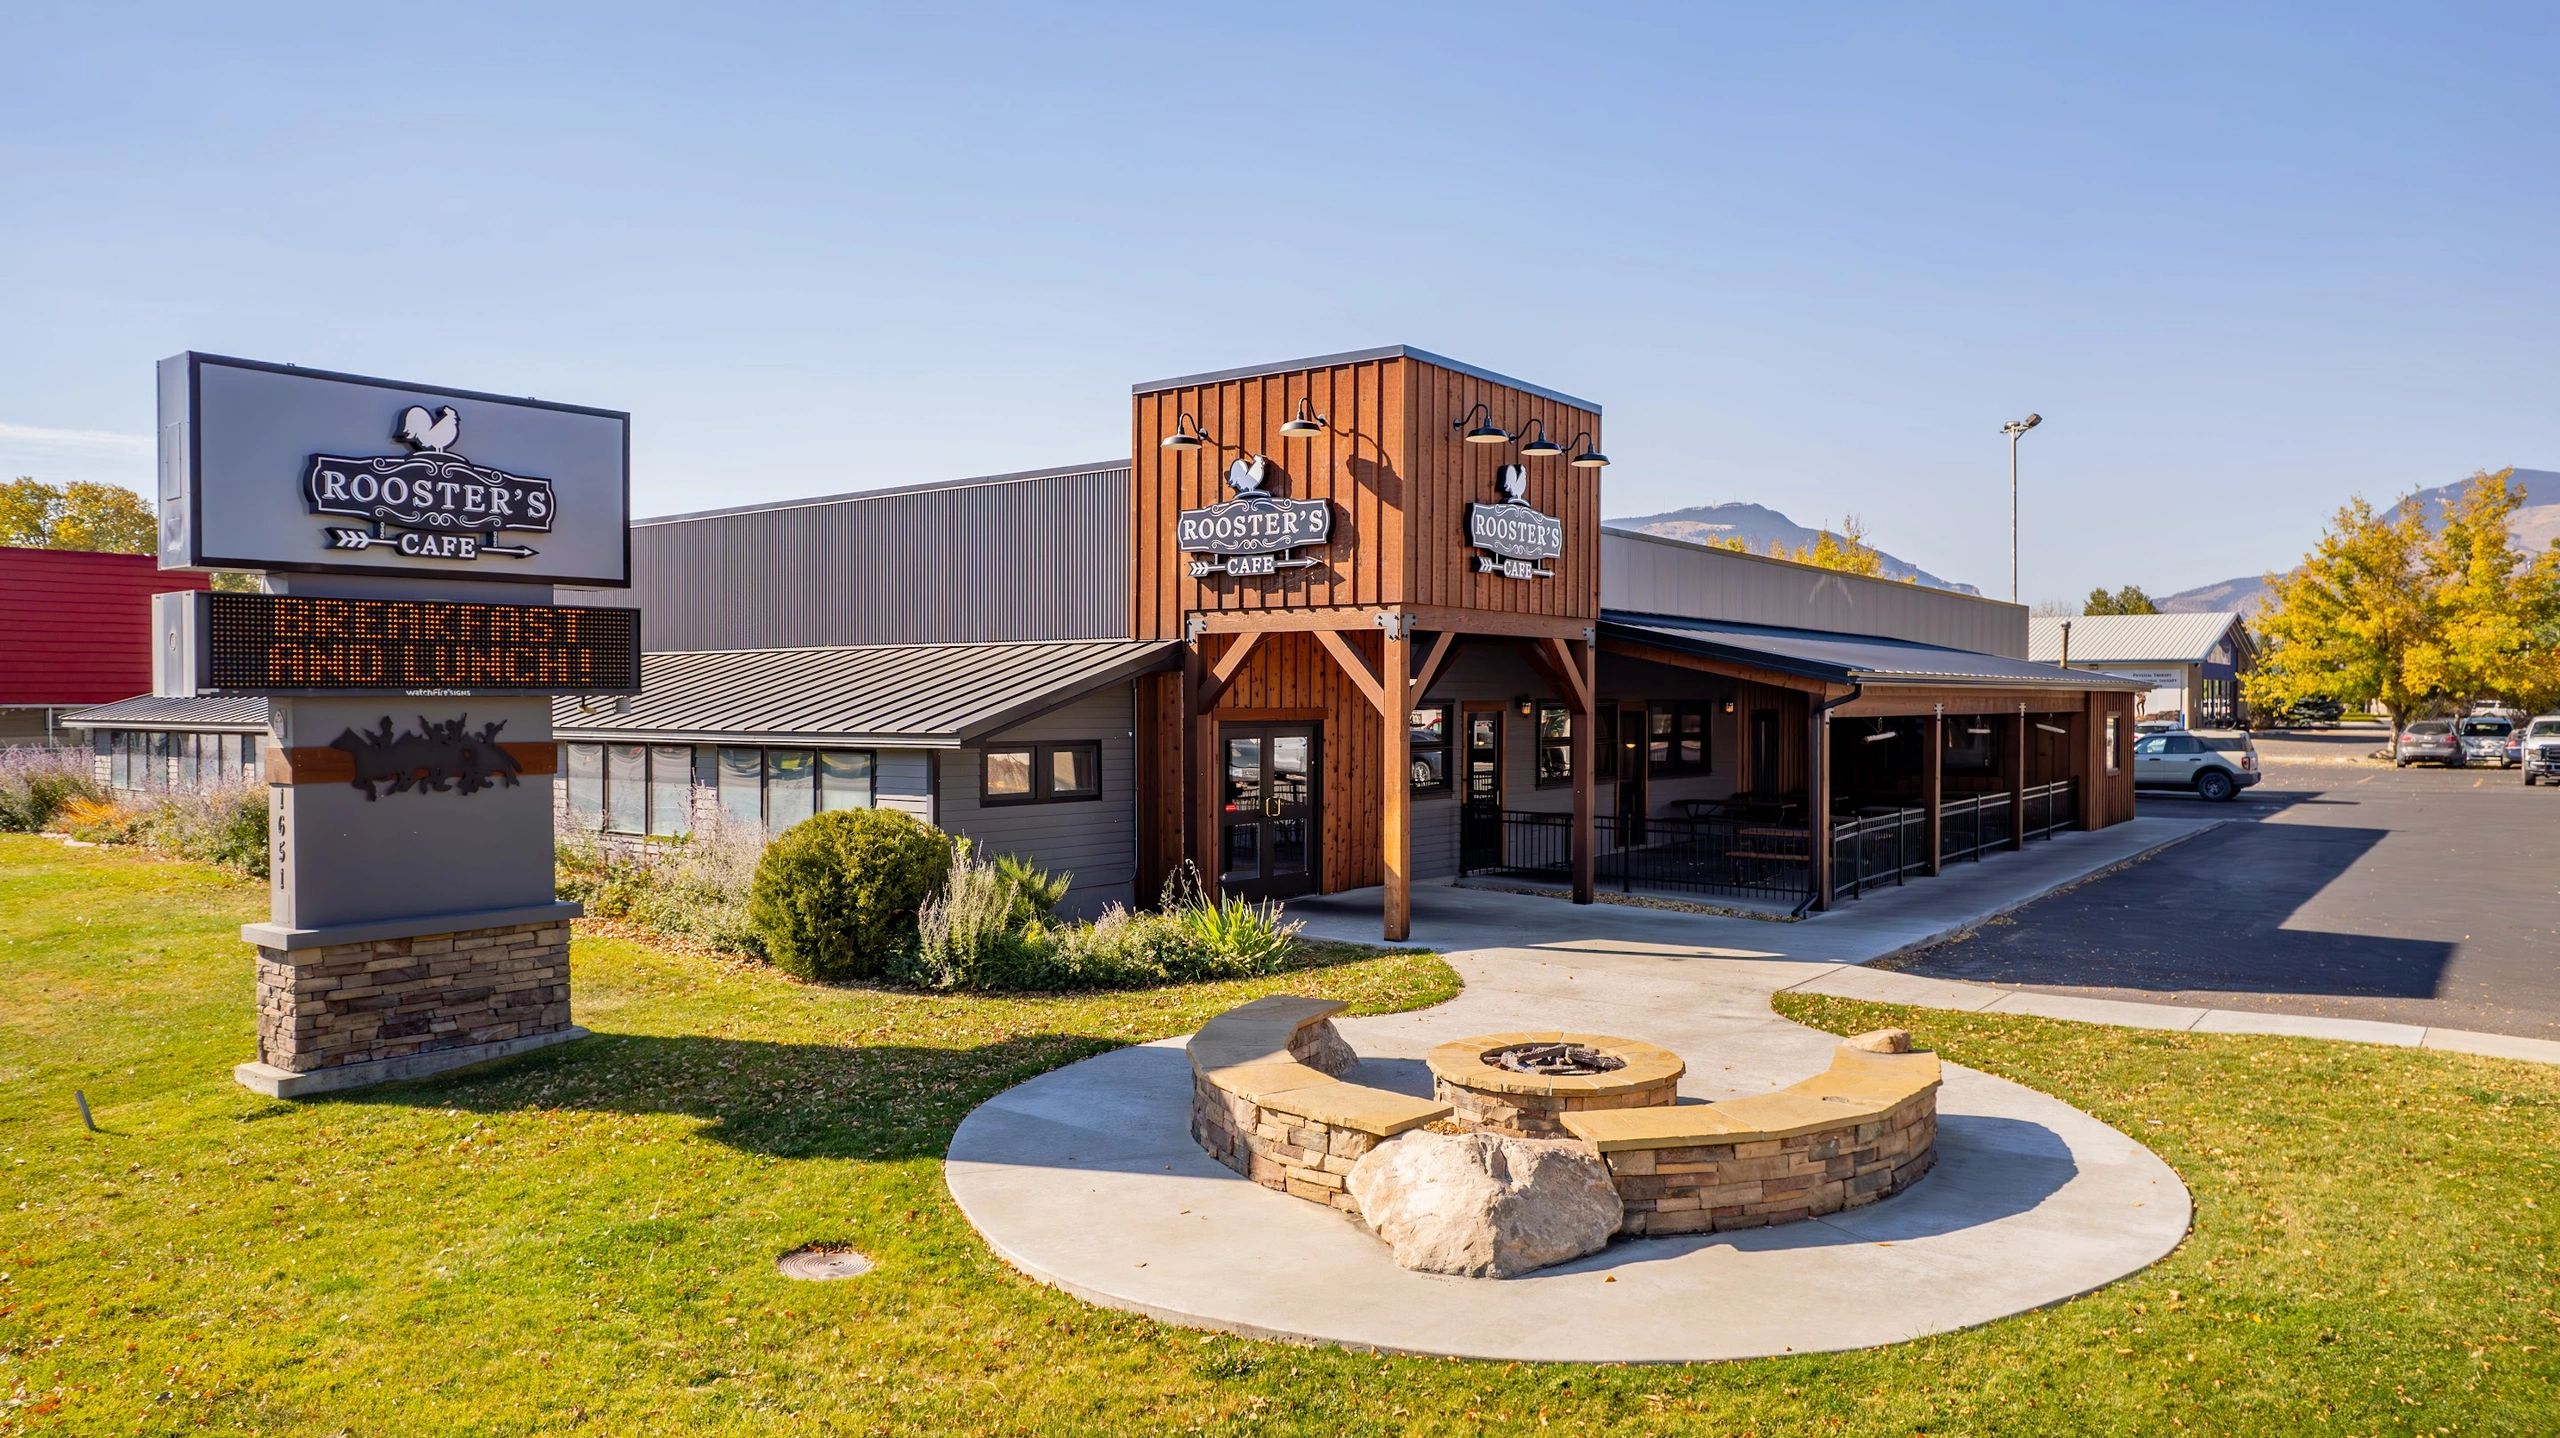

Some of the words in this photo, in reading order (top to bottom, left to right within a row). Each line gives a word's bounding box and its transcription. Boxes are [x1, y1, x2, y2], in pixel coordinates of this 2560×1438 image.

[321, 470, 547, 519] ROOSTER'S
[1183, 509, 1323, 541] ROOSTER'S
[1475, 514, 1560, 548] ROOSTER'S
[401, 533, 476, 558] CAFE
[1227, 556, 1275, 575] CAFE
[1503, 561, 1533, 578] CAFE
[274, 598, 586, 643] BREAKFAST
[268, 643, 383, 682] AND
[403, 645, 592, 683] LUNCH!
[278, 788, 286, 890] 1651
